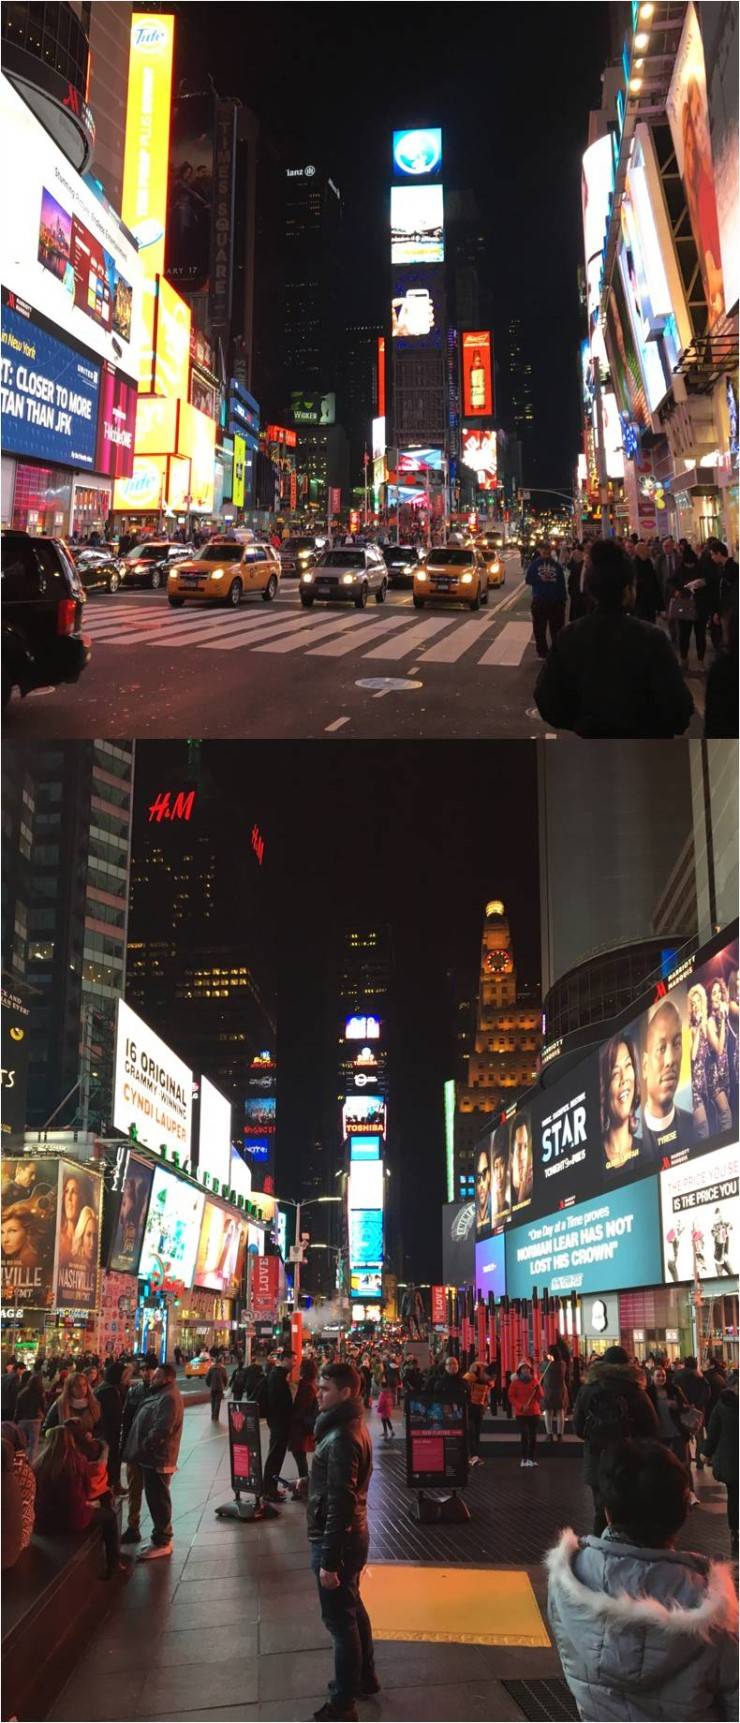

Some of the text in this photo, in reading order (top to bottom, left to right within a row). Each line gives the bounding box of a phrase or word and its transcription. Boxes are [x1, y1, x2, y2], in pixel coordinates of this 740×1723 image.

[216, 121, 231, 294] TIMES SQUARE
[8, 333, 23, 352] New
[23, 343, 36, 361] York
[16, 365, 54, 404] CLOSER
[55, 384, 68, 409] TO
[69, 391, 92, 420] MORE
[26, 396, 55, 430] THAN
[55, 410, 72, 436] JFK
[149, 791, 195, 822] H&M
[125, 1038, 188, 1108] 16 ORIGINAL
[123, 1082, 188, 1143] CYNDI LAUPER
[346, 1123, 385, 1133] TOSHIBA
[541, 1105, 588, 1163] STAR
[708, 1163, 726, 1180] YOU
[674, 1179, 738, 1211] IS THE PRICE YOU
[517, 1213, 634, 1262] NORMAN LEAR HAS NOT
[542, 1224, 554, 1238] Day
[554, 1220, 561, 1233] at
[567, 1215, 584, 1229] Time
[583, 1205, 610, 1226] proves
[58, 1267, 95, 1292] NASHVILLE
[259, 1257, 269, 1292] LOVE
[529, 1256, 553, 1276] LOST
[553, 1251, 570, 1270] HIS
[435, 1287, 443, 1310] LOVE
